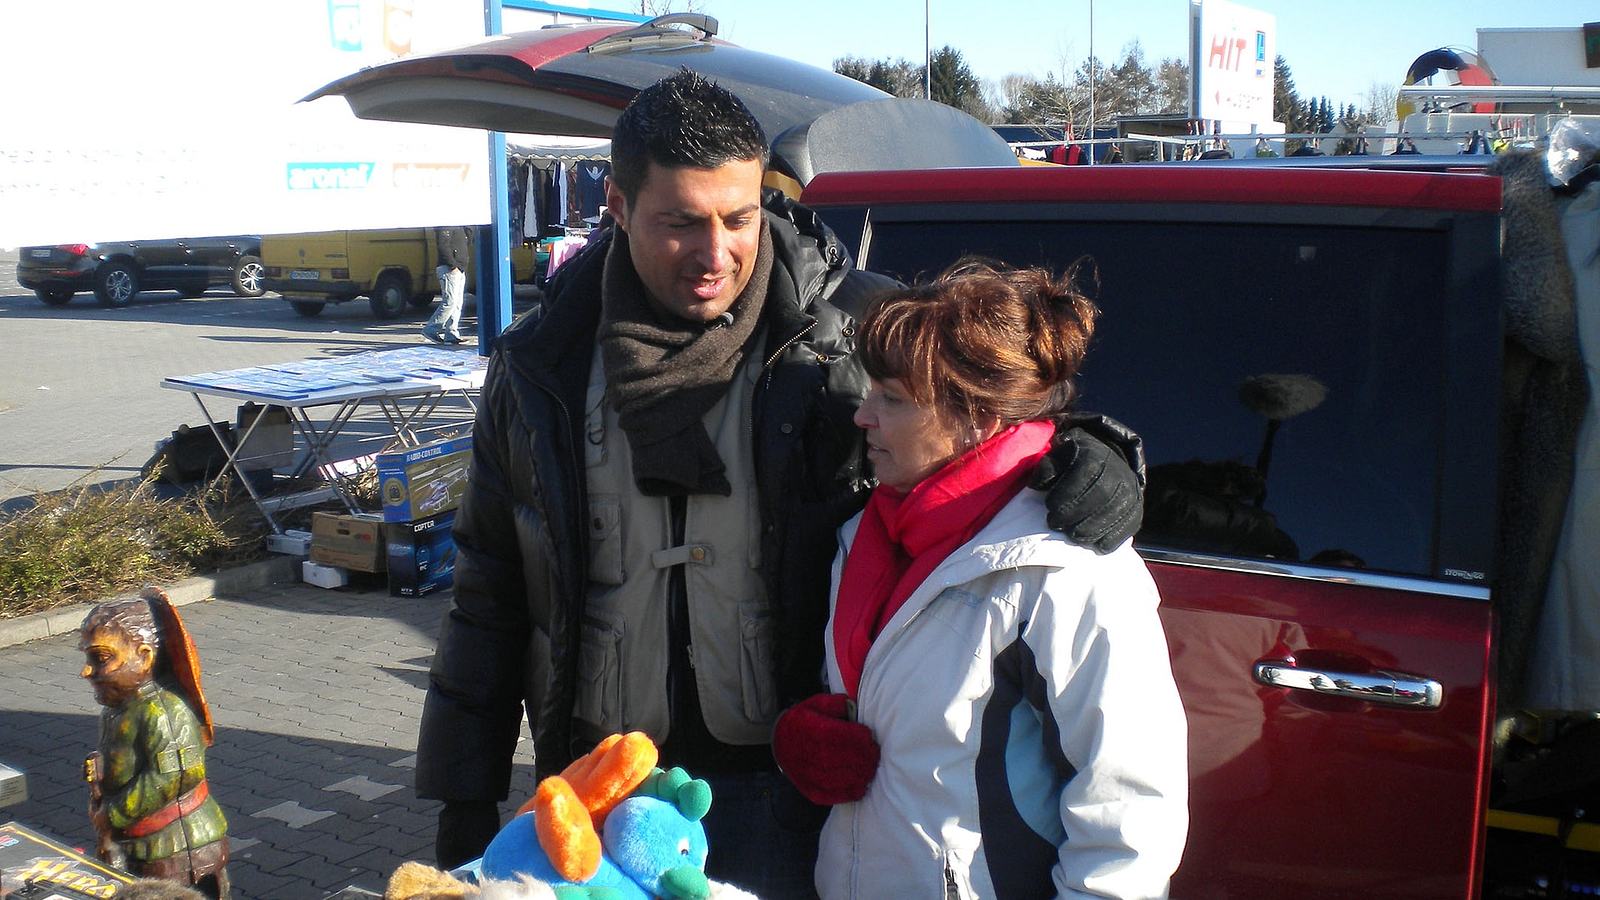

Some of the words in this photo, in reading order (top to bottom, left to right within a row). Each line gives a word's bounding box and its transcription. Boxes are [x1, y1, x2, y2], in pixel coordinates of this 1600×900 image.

[1209, 33, 1247, 72] HIT
[406, 447, 442, 462] RADIO-CONTROL
[413, 520, 435, 532] COPTER
